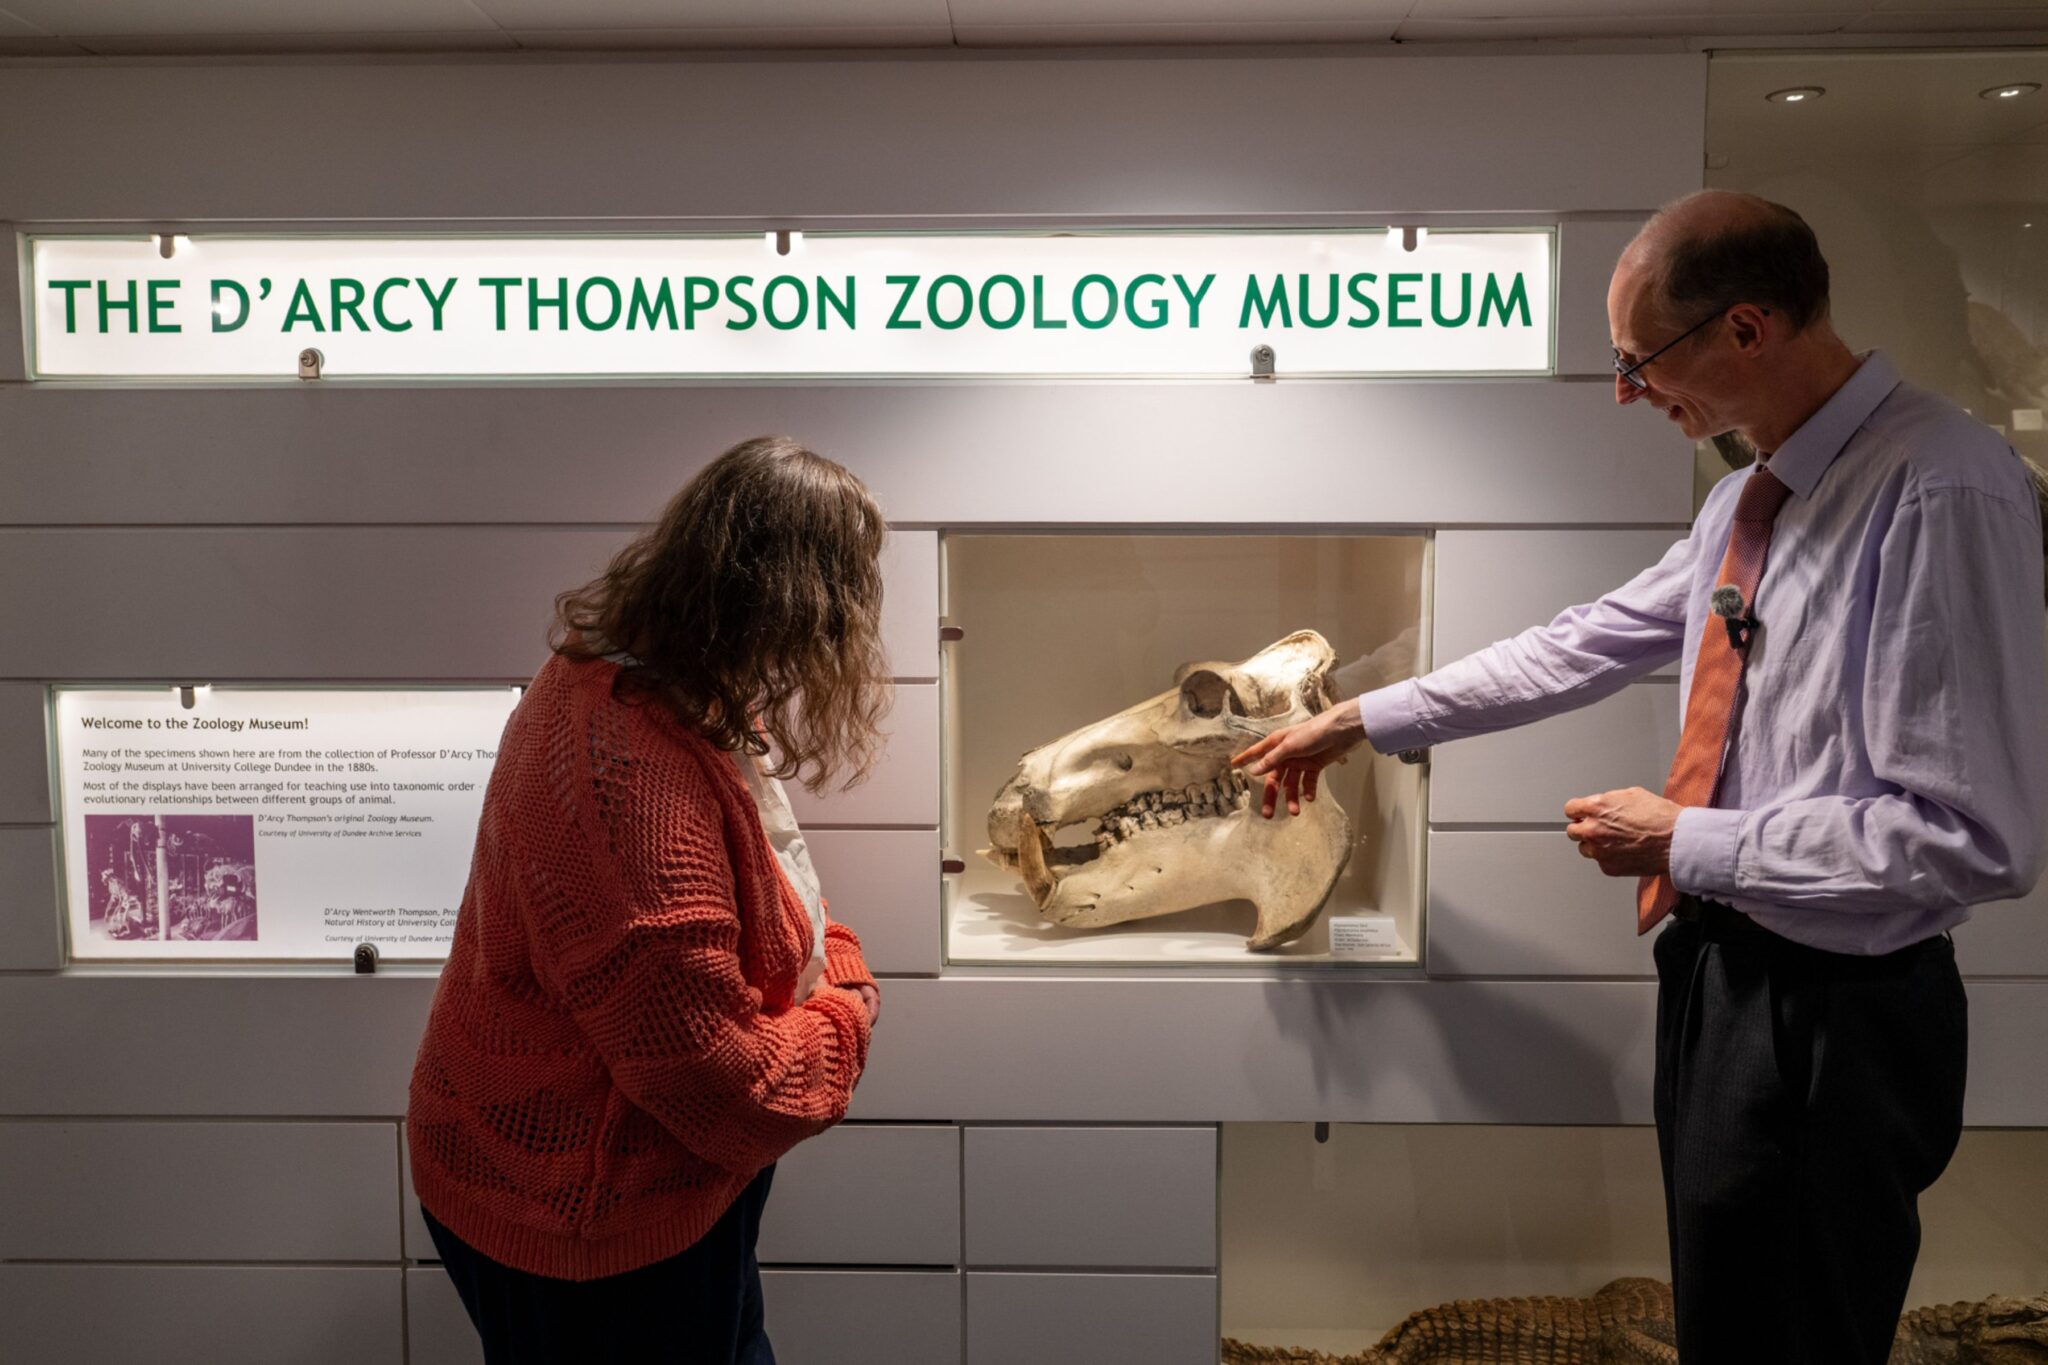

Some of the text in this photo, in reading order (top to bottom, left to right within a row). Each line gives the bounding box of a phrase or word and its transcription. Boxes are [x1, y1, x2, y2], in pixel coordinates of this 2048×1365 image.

[48, 272, 1532, 333] THE D’ARCY THOMPSON ZOOLOGY MUSEUM
[81, 717, 308, 732] Welcome to the Zoology Museum!
[83, 749, 108, 759] Many
[111, 749, 121, 758] of
[125, 749, 141, 758] the
[144, 750, 196, 759] specimens
[199, 749, 230, 758] shown
[233, 749, 255, 758] here
[278, 749, 302, 758] from
[305, 749, 322, 758] the
[325, 749, 374, 759] collection
[377, 750, 387, 759] of
[391, 749, 436, 759] Professor
[440, 749, 473, 760] D'Arcy
[84, 762, 378, 774] Zoology Museum at University College Dundee in the 1880s.
[83, 782, 105, 790] Most
[109, 781, 119, 790] of
[123, 781, 139, 790] the
[142, 782, 182, 792] displays
[185, 782, 208, 790] have
[212, 782, 236, 791] been
[239, 782, 283, 793] arranged
[287, 782, 301, 791] for
[304, 782, 347, 793] teaching
[370, 782, 390, 791] into
[393, 783, 444, 791] taxonomic
[448, 782, 475, 791] order
[84, 794, 395, 806] evolutionary relationships between different groups of animal.
[258, 814, 284, 824] D'Arcy
[287, 814, 332, 823] Thompson's
[334, 815, 364, 824] original
[367, 814, 398, 824] Zoology
[258, 830, 288, 838] Courtesy
[298, 830, 332, 838] University
[324, 908, 457, 917] D'Arcy Wentworth Thompson, Pro
[356, 919, 385, 927] History
[398, 919, 438, 928] University
[440, 919, 455, 927] Coll
[325, 935, 354, 943] Courtesy
[364, 936, 398, 944] University
